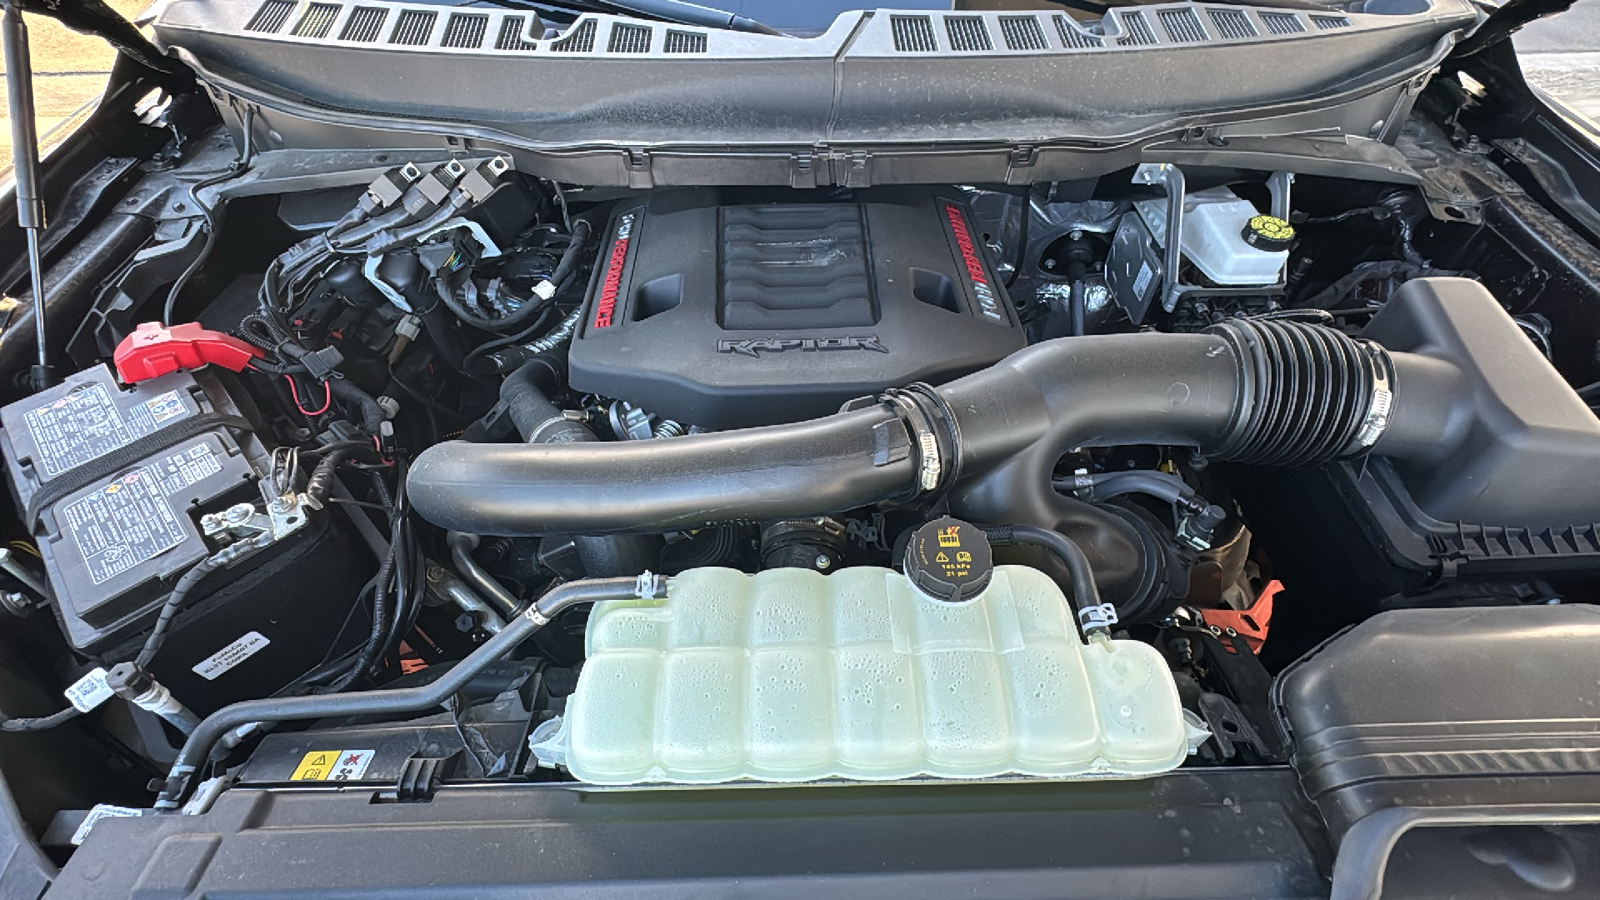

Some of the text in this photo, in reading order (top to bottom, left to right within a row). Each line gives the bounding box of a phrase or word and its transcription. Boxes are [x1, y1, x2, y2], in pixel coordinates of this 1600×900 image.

[593, 238, 629, 329] PERFORMANCE
[717, 335, 890, 358] RAPTOR
[957, 570, 969, 578] psi
